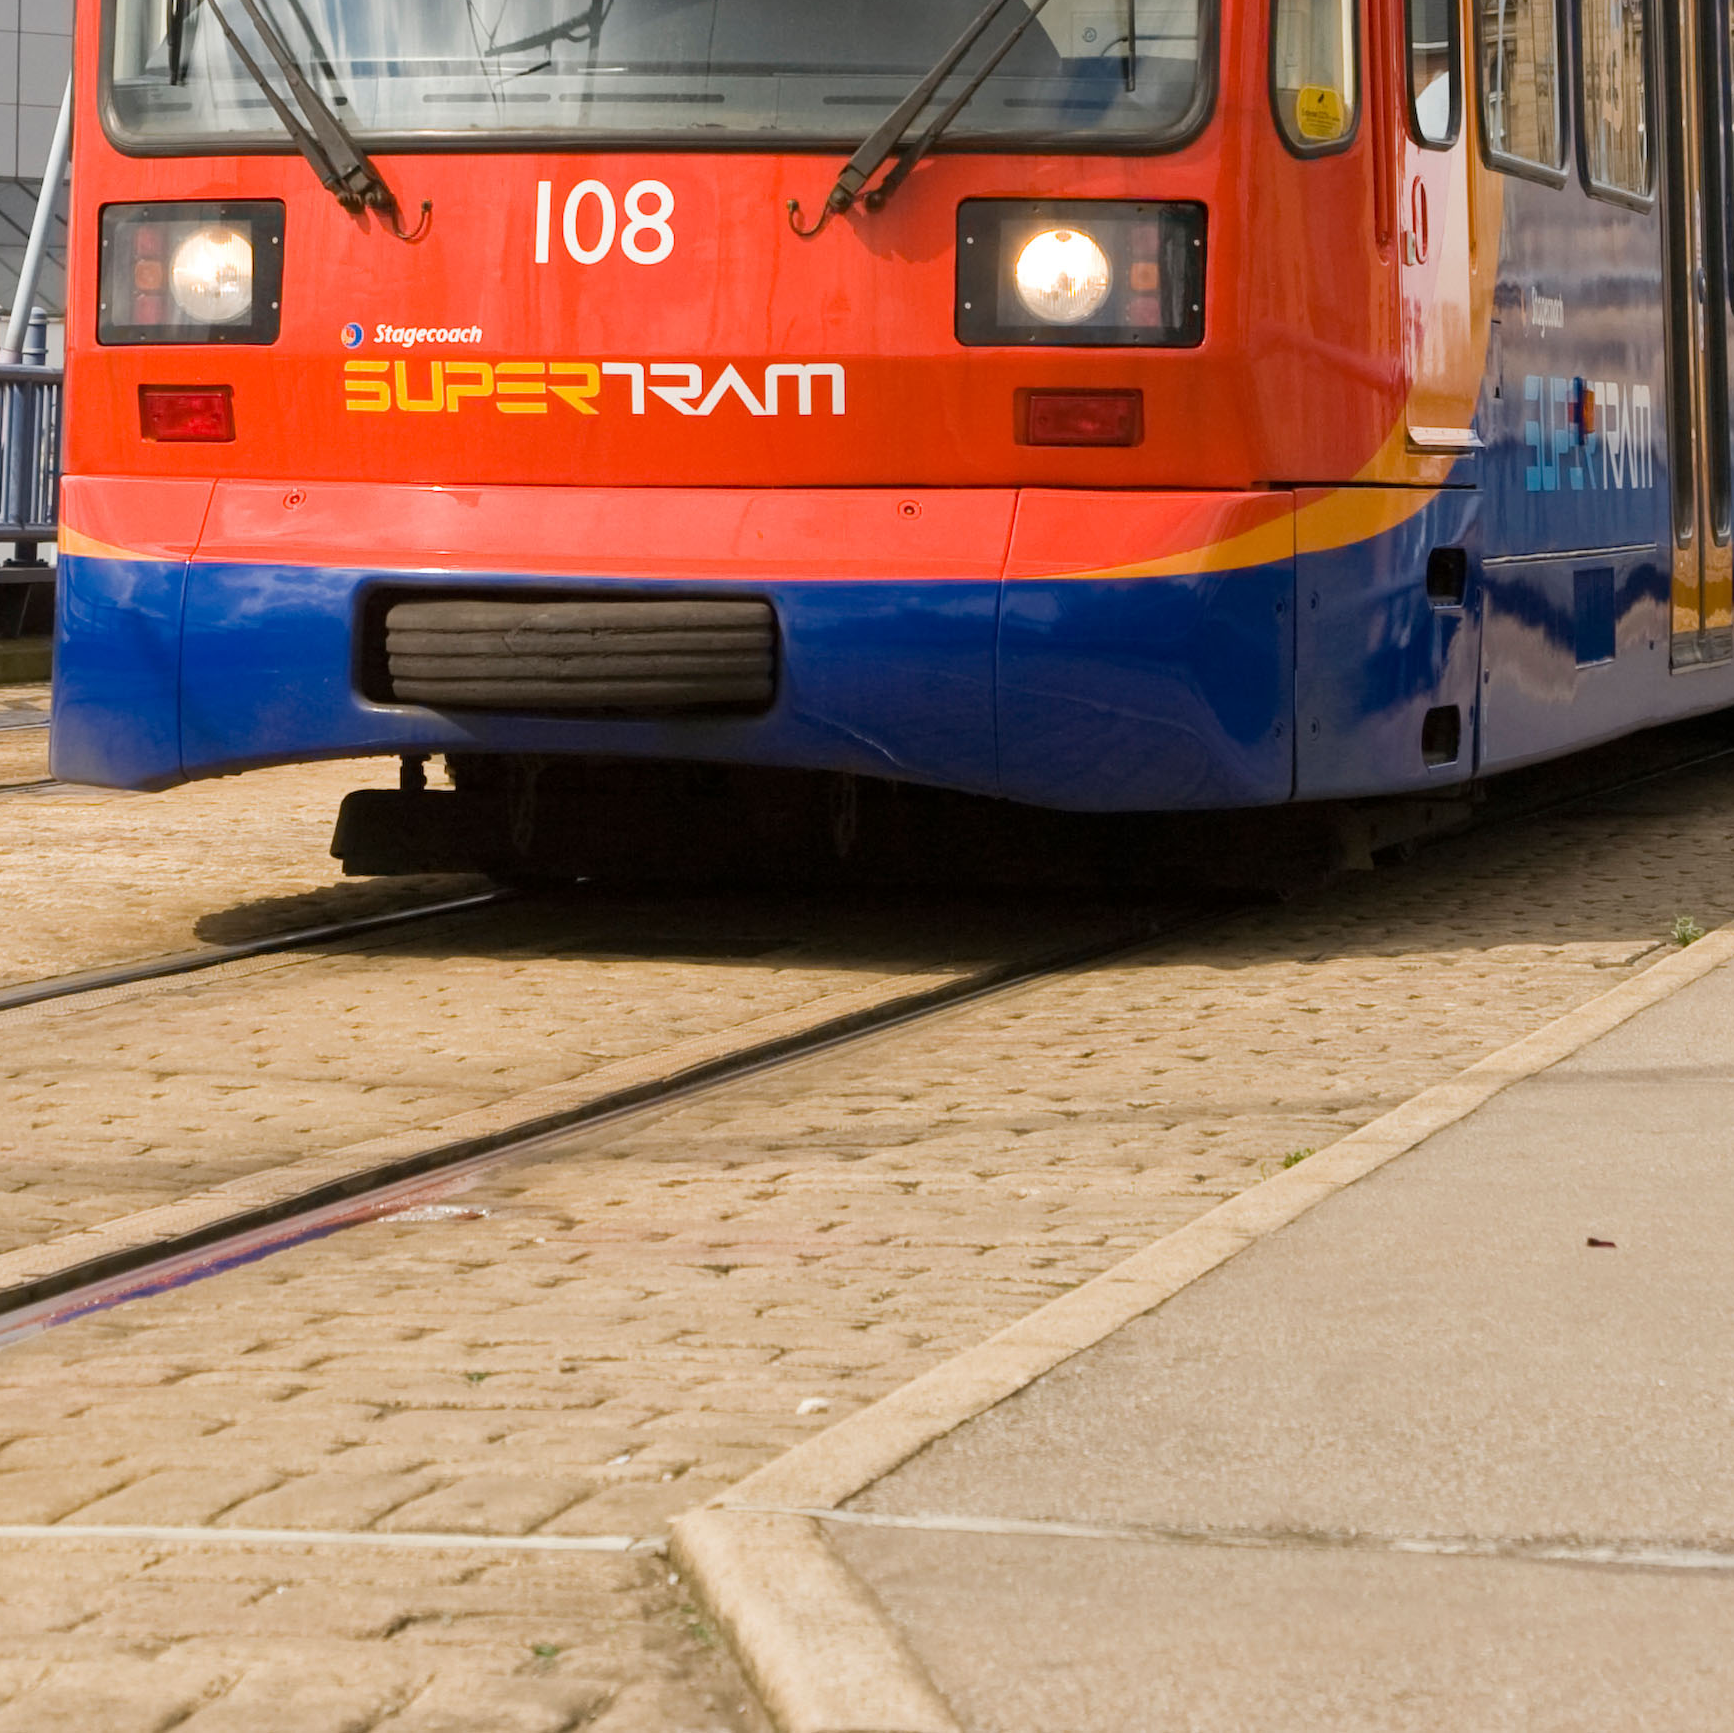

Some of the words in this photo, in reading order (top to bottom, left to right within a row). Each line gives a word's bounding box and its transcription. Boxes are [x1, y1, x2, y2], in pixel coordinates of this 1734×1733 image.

[535, 180, 676, 265] 108
[373, 323, 483, 348] Stagecoach
[344, 360, 847, 416] SUPERTRAM
